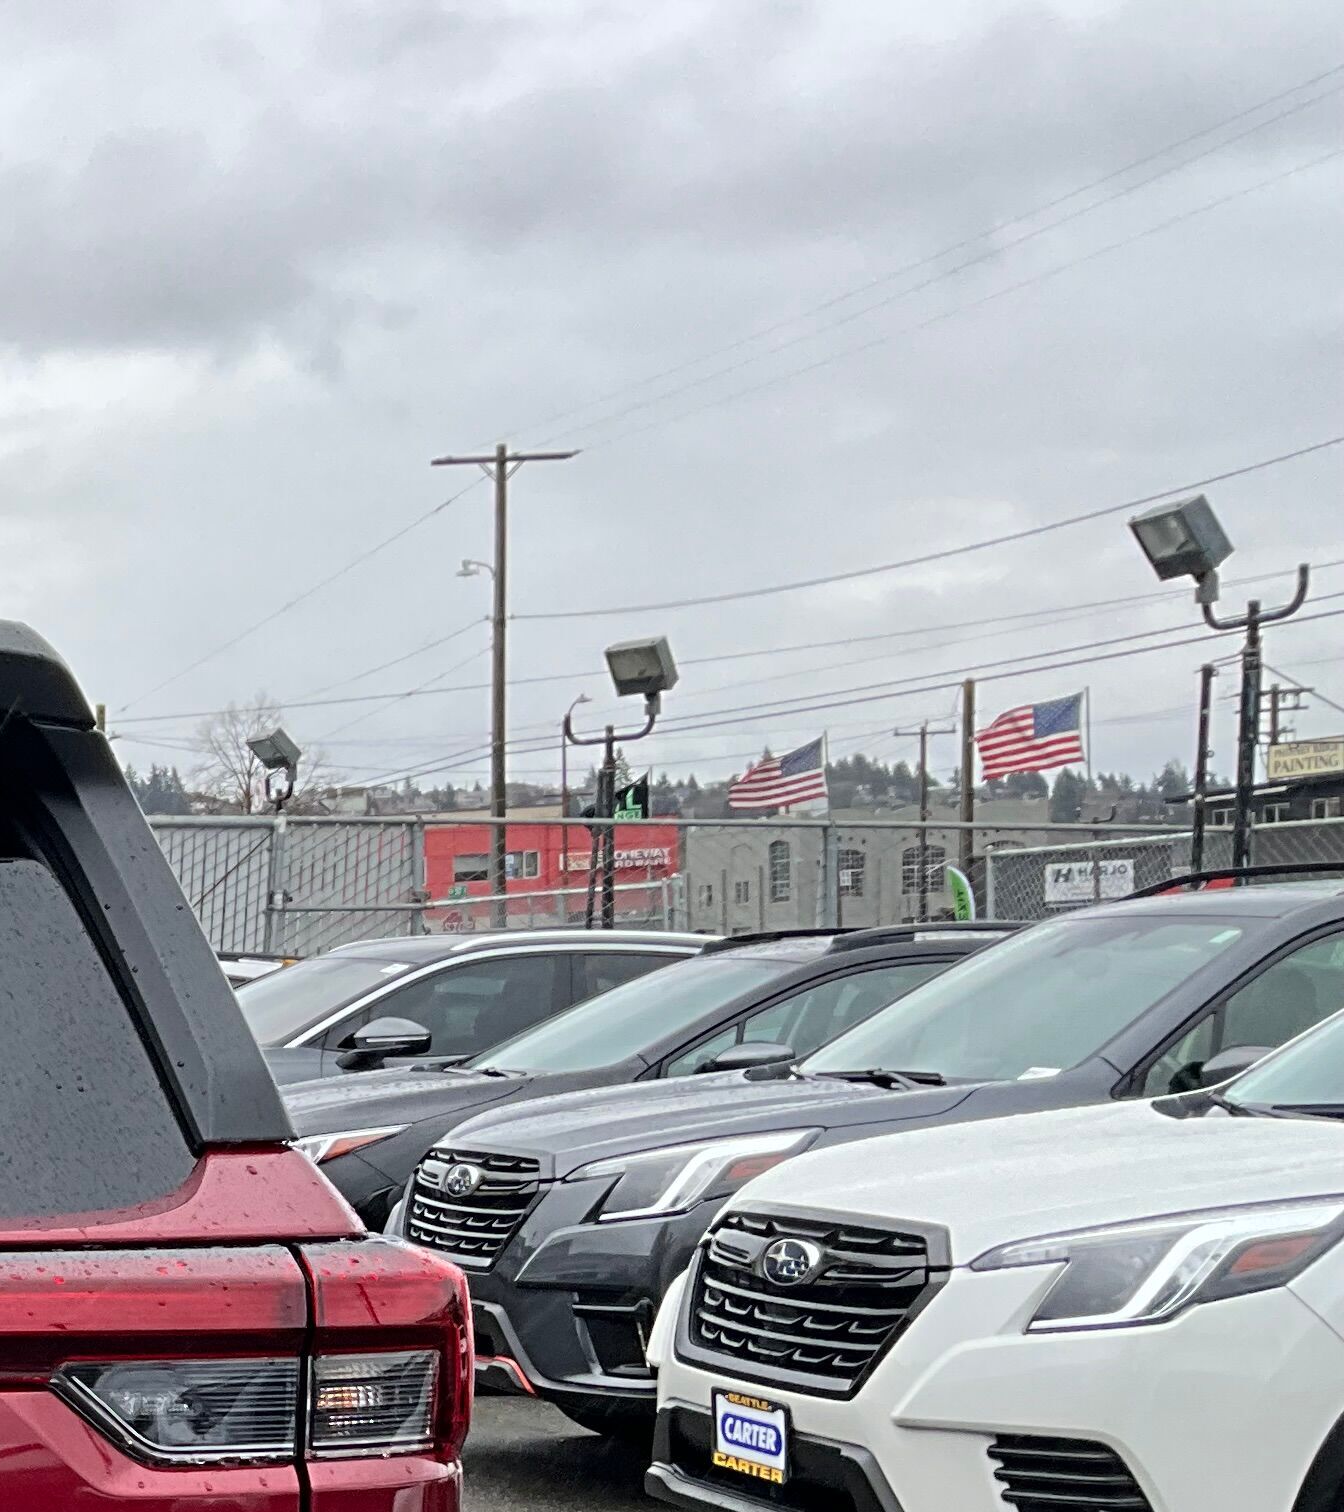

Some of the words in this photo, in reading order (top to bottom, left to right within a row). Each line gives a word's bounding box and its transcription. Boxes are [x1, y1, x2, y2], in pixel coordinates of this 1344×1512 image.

[1274, 754, 1339, 774] PAINTING
[596, 858, 672, 868] RDWARE
[597, 848, 671, 860] SONEWAY
[728, 1393, 768, 1411] SEATTLE
[724, 1417, 777, 1452] CARTER
[713, 1452, 782, 1484] CARTER
